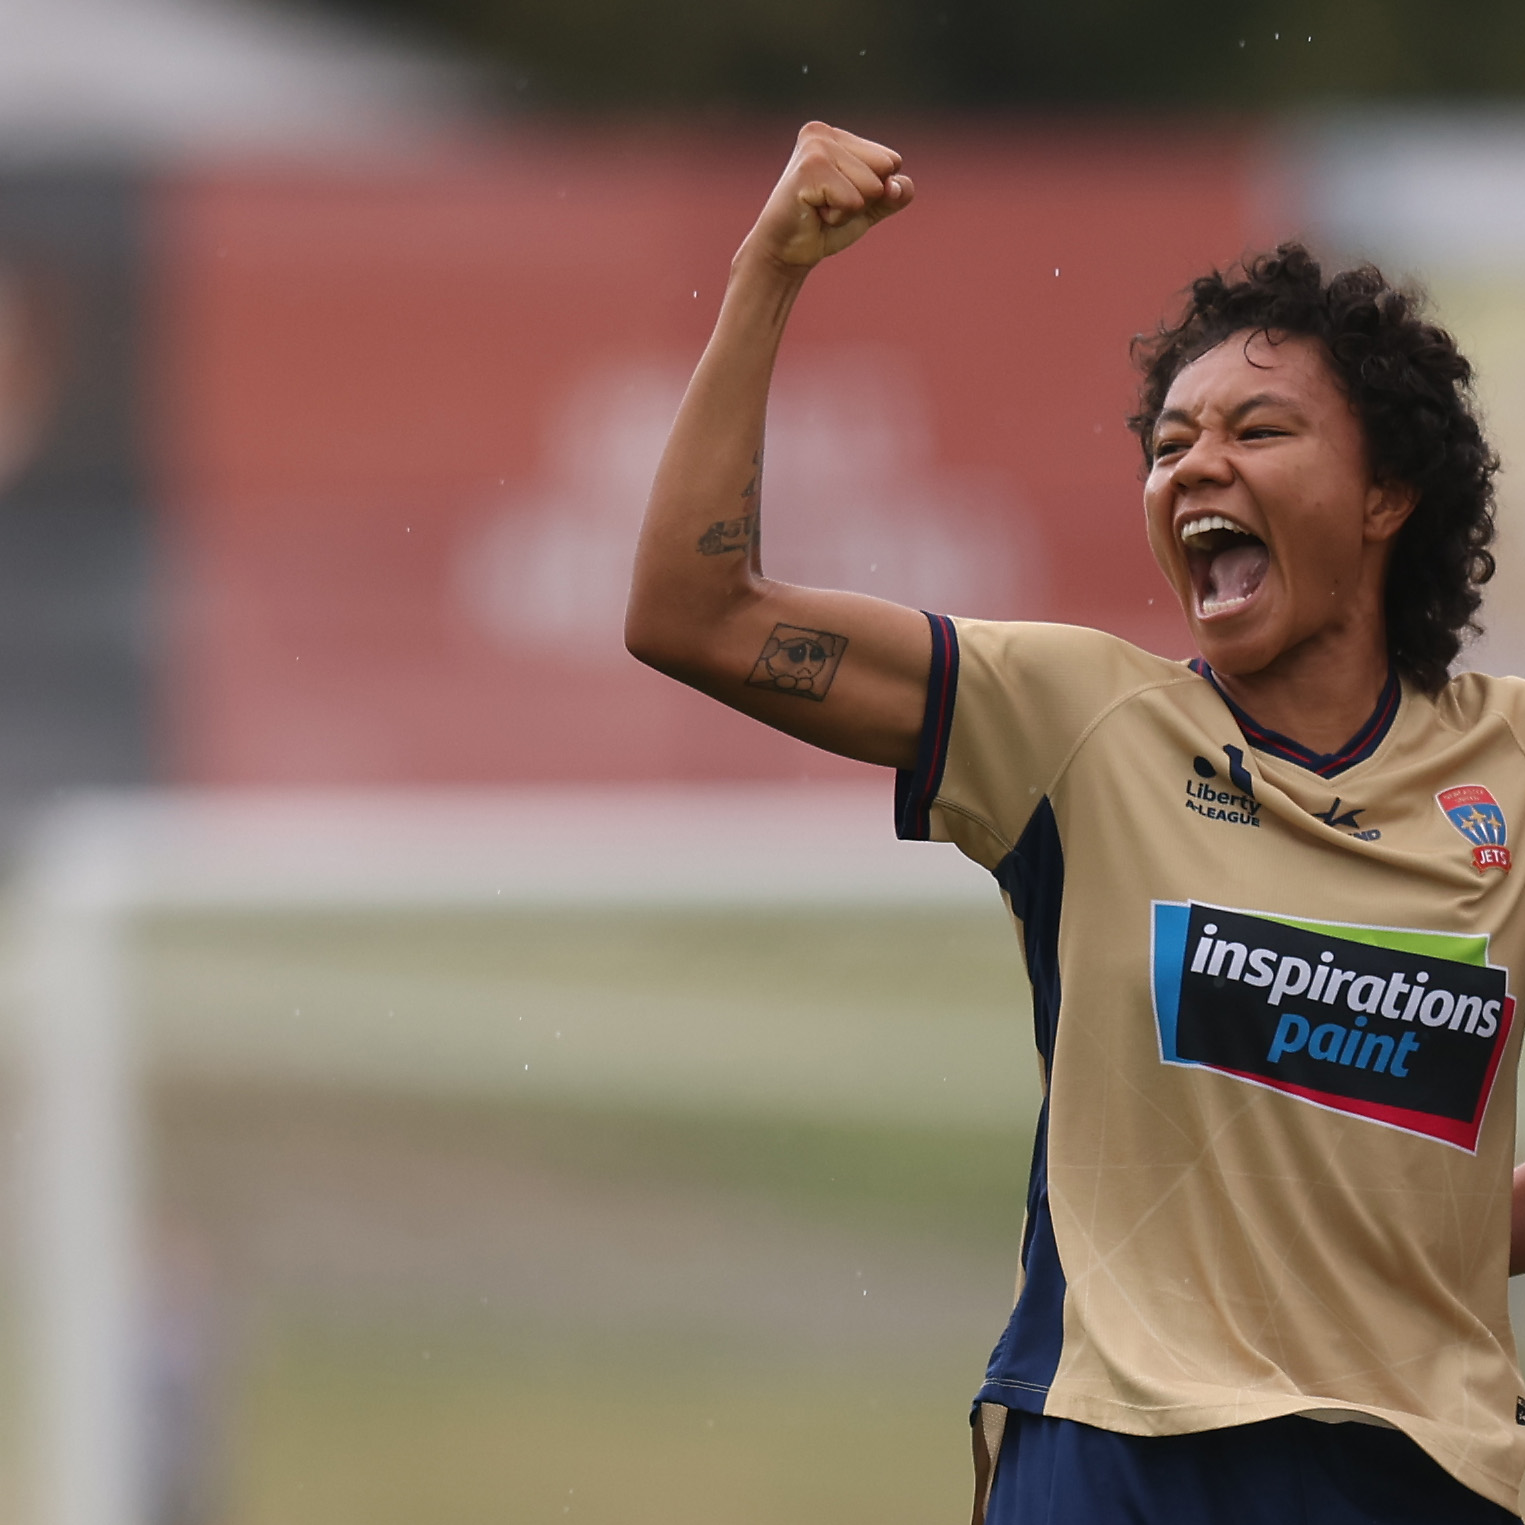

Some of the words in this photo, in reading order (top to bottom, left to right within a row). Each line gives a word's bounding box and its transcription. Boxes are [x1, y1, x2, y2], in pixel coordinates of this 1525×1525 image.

[1185, 799, 1261, 828] A-LEAGUE
[1186, 780, 1262, 816] Liberty
[1480, 849, 1508, 866] JETS
[1190, 922, 1502, 1039] inspirations
[1266, 1013, 1421, 1078] paint
